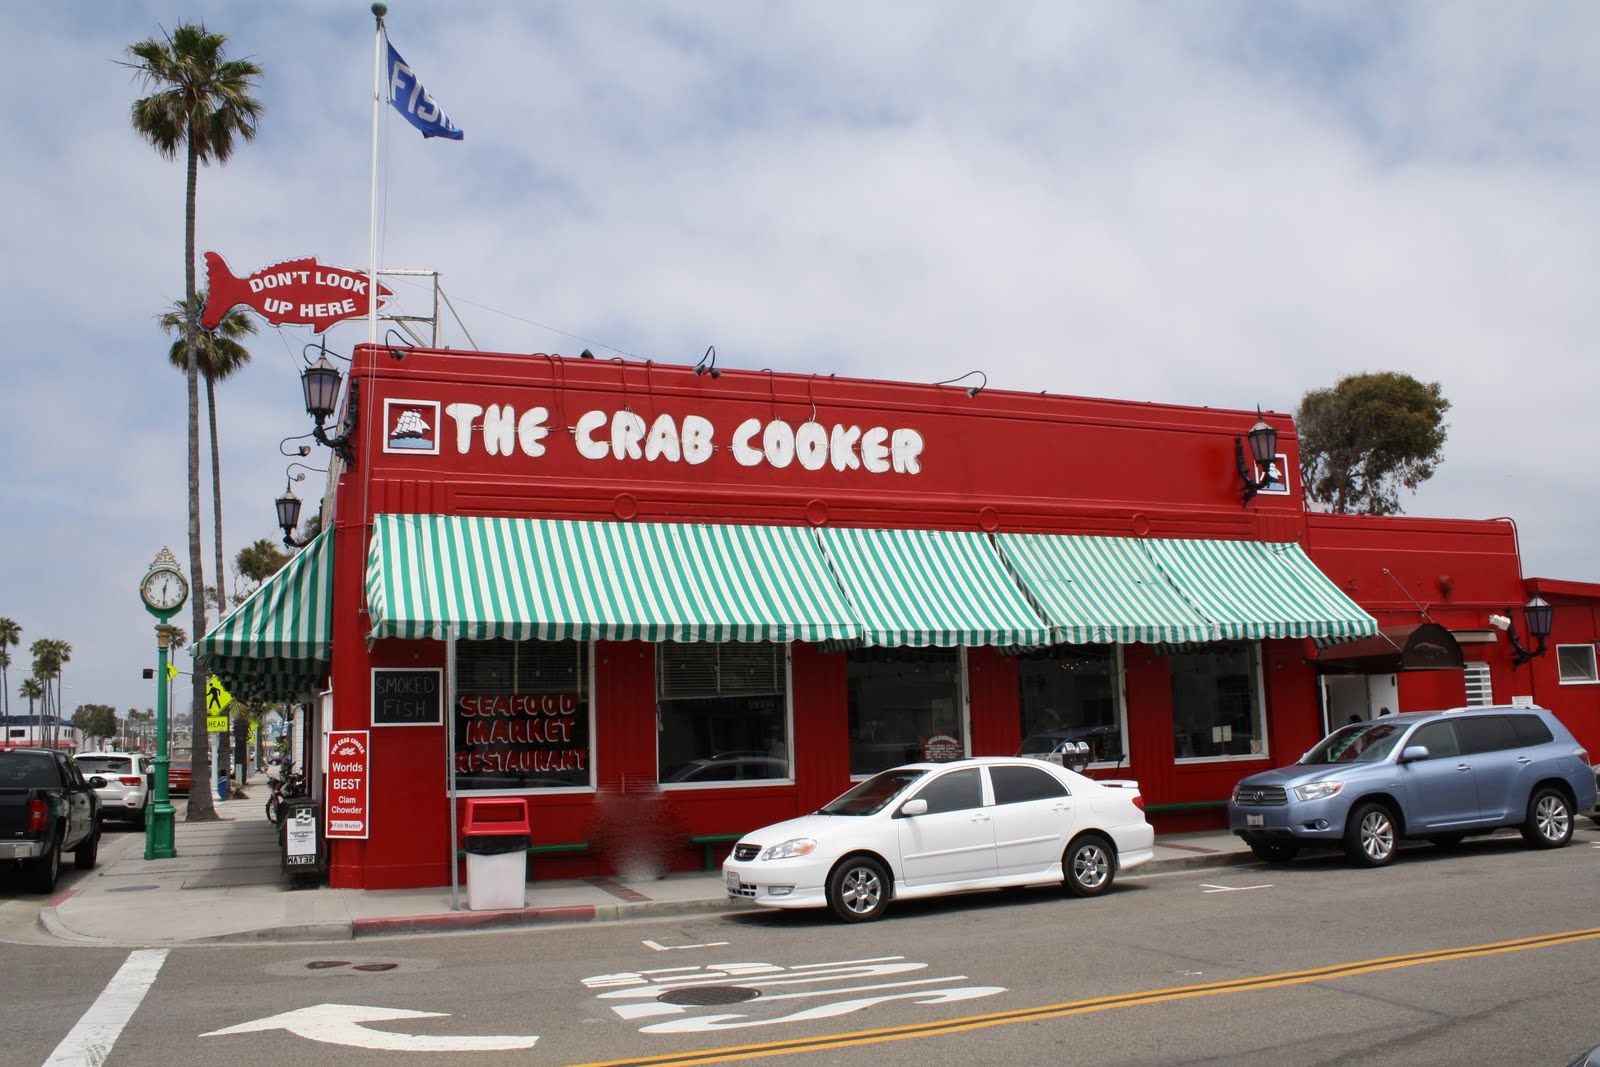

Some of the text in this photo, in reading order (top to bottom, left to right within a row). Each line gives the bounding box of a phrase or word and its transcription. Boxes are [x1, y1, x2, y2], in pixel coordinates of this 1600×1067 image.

[249, 271, 369, 295] DON'T LOOK
[263, 298, 357, 317] UP HERE
[445, 403, 924, 475] THE CRAB COOKER
[376, 676, 434, 694] SMOKED
[460, 693, 577, 717] SEAFOOD
[208, 720, 226, 728] HEAD
[466, 718, 575, 745] MARKET
[332, 762, 363, 773] Worlds
[455, 749, 587, 773] RESTAURANT
[333, 778, 361, 790] BEST
[338, 795, 356, 804] Clam
[331, 805, 363, 814] Chowder
